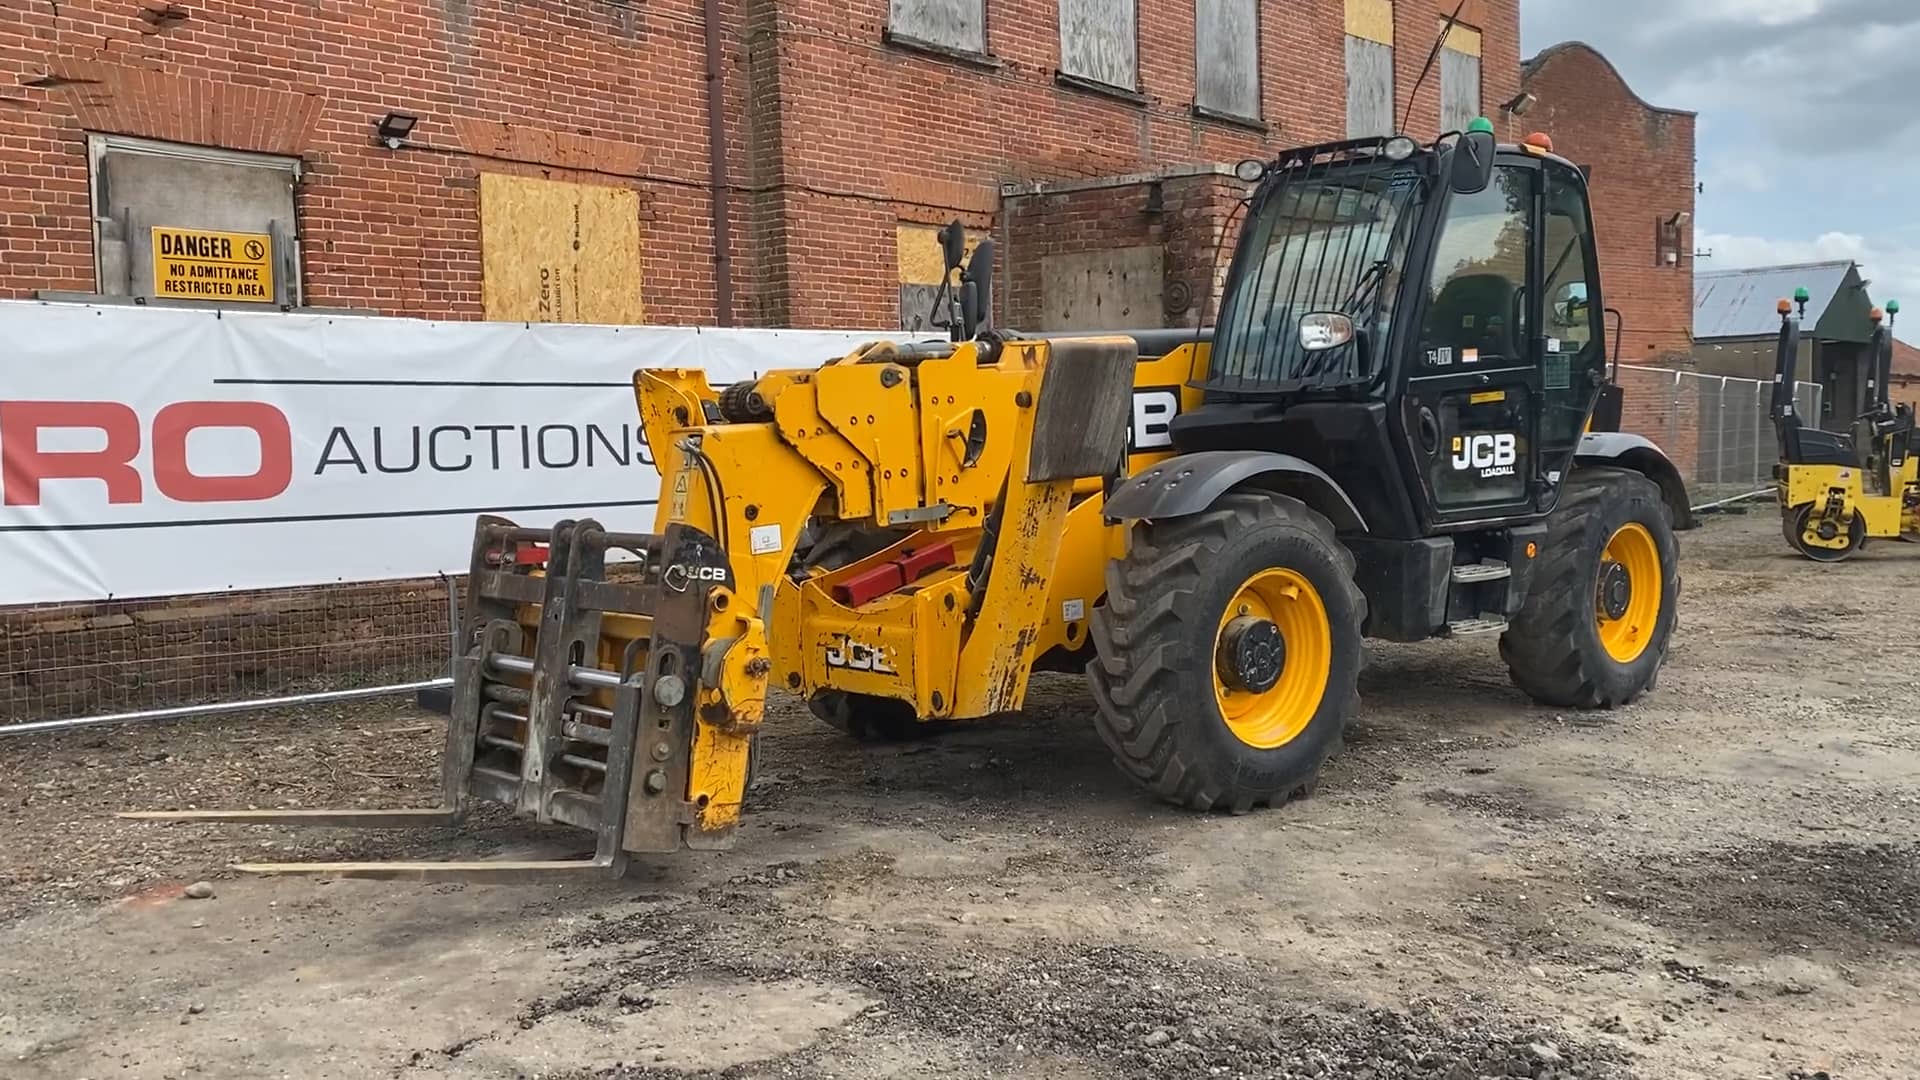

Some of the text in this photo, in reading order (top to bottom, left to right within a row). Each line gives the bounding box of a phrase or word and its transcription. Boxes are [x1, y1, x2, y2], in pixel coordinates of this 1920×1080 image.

[161, 234, 232, 259] DANGER
[170, 264, 259, 280] NO ADMITTANCE
[165, 280, 265, 296] RESTRICTED AREA
[539, 268, 550, 313] Zero
[0, 400, 293, 506] RO
[1452, 433, 1516, 470] JCB
[1481, 465, 1515, 478] LOADALL
